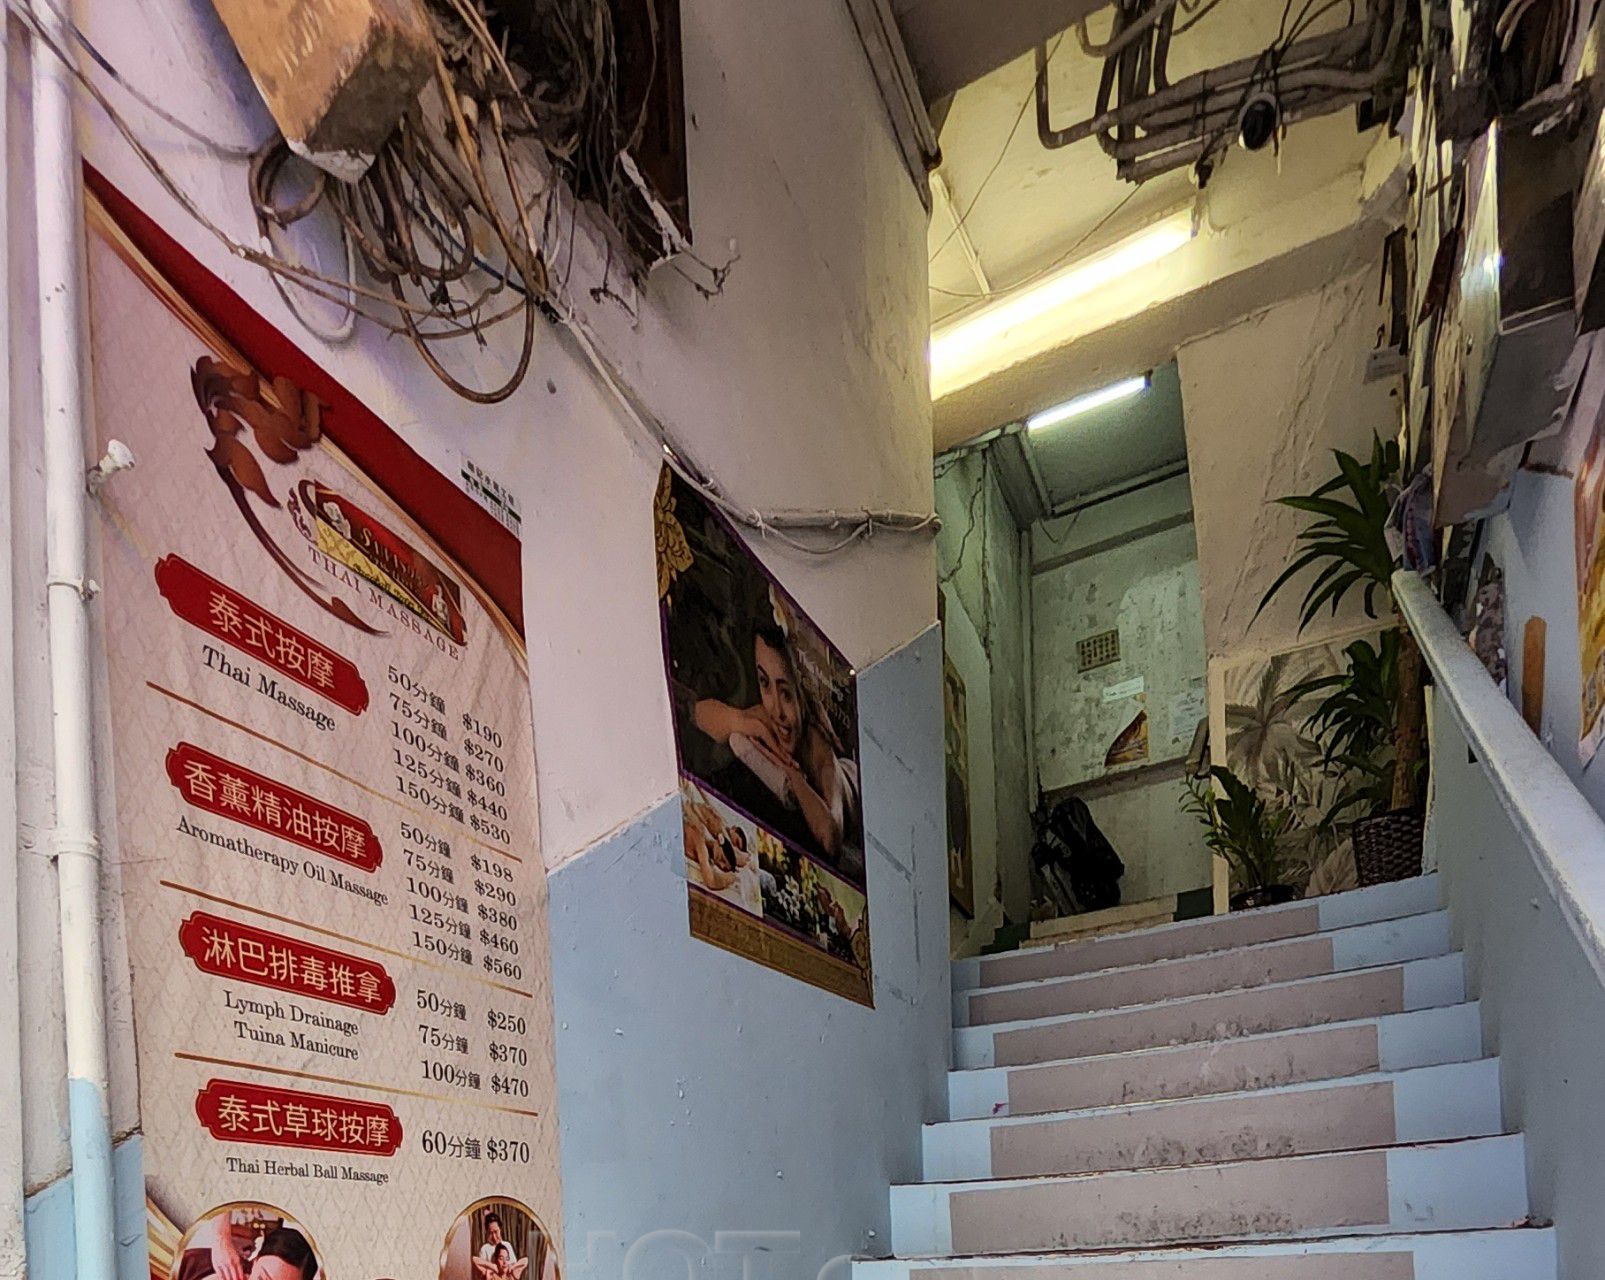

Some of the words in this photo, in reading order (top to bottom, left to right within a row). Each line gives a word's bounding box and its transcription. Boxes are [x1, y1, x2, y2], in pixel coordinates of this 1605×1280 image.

[307, 544, 361, 593] THAI
[369, 587, 459, 660] MASSAGE
[208, 593, 336, 690] 泰式按摩
[202, 644, 252, 685] Thai
[256, 673, 336, 732] Massage
[388, 665, 446, 715] 50分鐘
[462, 713, 503, 748] $190
[389, 693, 448, 741] 75分鐘
[464, 738, 504, 773] $270
[391, 720, 460, 774] 100分鐘
[465, 764, 505, 797] $360
[183, 758, 368, 860] 香薰精油按摩
[393, 748, 462, 799] 125分鐘
[467, 788, 508, 821] $440
[395, 775, 465, 824] 150分鐘
[470, 814, 511, 845] $530
[176, 815, 299, 875] Aromatherapy
[303, 861, 327, 883] Oil
[328, 869, 389, 906] Massage
[400, 822, 451, 859] 50分鐘
[470, 853, 514, 883] $198
[403, 848, 454, 884] 75分鐘
[474, 878, 516, 907] $290
[406, 876, 470, 914] 100分鐘
[477, 903, 518, 931] $380
[409, 903, 472, 940] 125分鐘
[479, 928, 519, 955] $460
[200, 925, 383, 1005] 淋巴排毒推拿
[412, 930, 474, 966] 150分鐘
[483, 954, 522, 981] $560
[223, 990, 285, 1021] Lymph
[290, 1005, 360, 1038] Drainage
[234, 1021, 286, 1048] Tuina
[290, 1032, 359, 1061] Manicure
[416, 989, 467, 1022] 50分鐘
[487, 1007, 527, 1037] $250
[418, 1024, 469, 1056] 75分鐘
[489, 1041, 528, 1068] $370
[420, 1059, 481, 1092] 100分鐘
[491, 1075, 530, 1098] $470
[217, 1095, 391, 1149] 泰式草球按摩
[421, 1129, 483, 1162] 60分鐘
[486, 1139, 531, 1165] $370
[226, 1157, 260, 1174] Thai
[263, 1160, 310, 1179] Herbal
[313, 1164, 339, 1180] Ball
[341, 1166, 389, 1186] Massage
